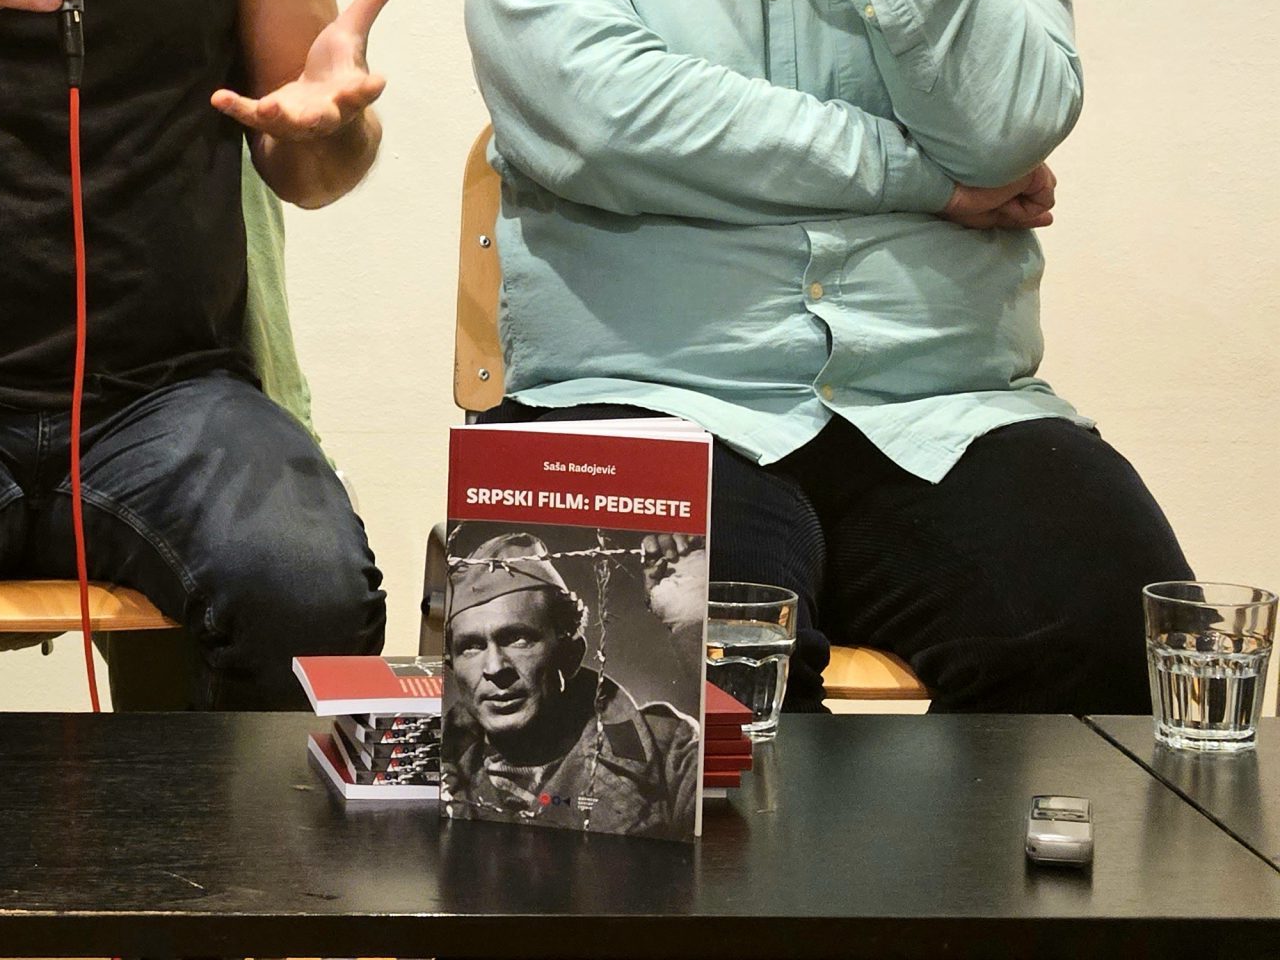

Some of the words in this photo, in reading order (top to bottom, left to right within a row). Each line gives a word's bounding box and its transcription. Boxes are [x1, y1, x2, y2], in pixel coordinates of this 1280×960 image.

[543, 461, 567, 472] Saša
[568, 462, 616, 476] Radojević
[466, 487, 533, 507] SRPSKI
[538, 491, 590, 511] FILM:
[594, 494, 691, 518] PEDESETE
